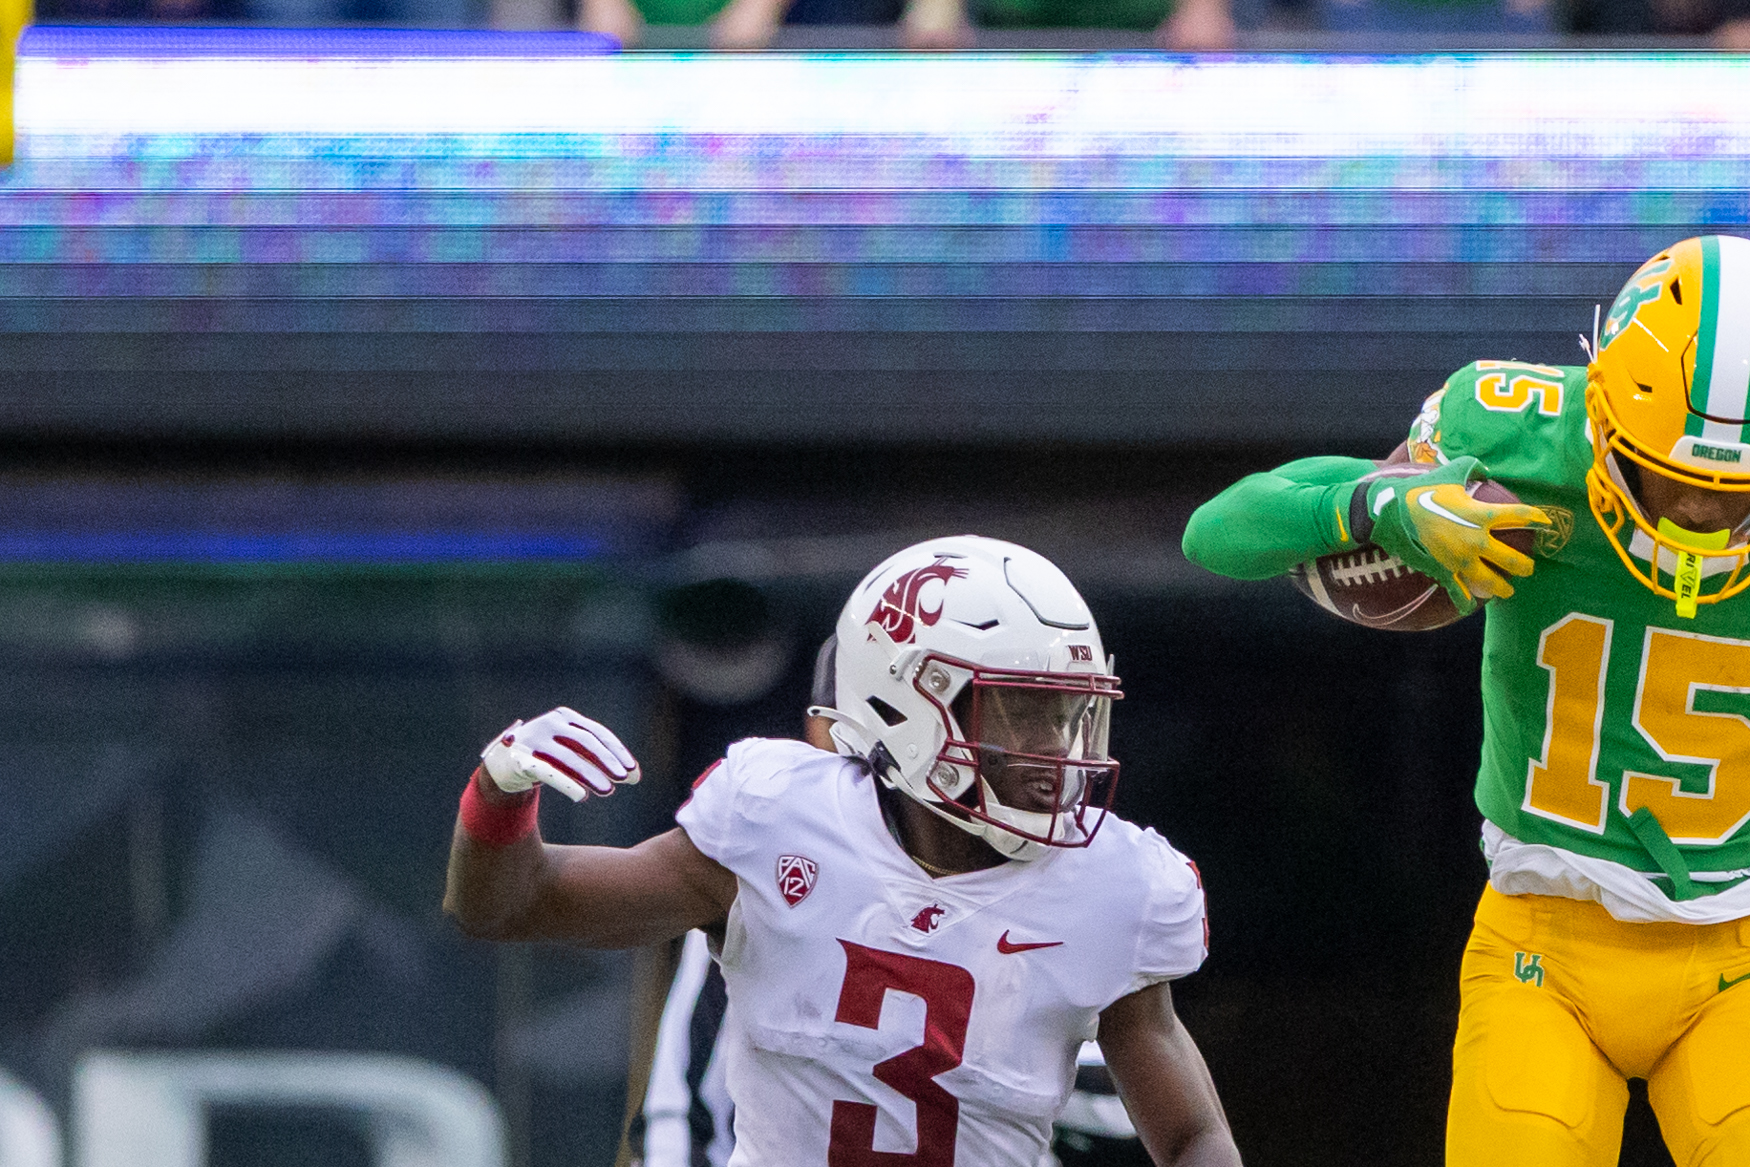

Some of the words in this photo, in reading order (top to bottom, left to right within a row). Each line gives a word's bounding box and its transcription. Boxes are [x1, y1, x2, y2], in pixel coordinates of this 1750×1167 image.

[1692, 443, 1742, 463] OREGON
[1067, 644, 1093, 661] WSU
[778, 856, 816, 889] PAC
[784, 876, 804, 897] 12
